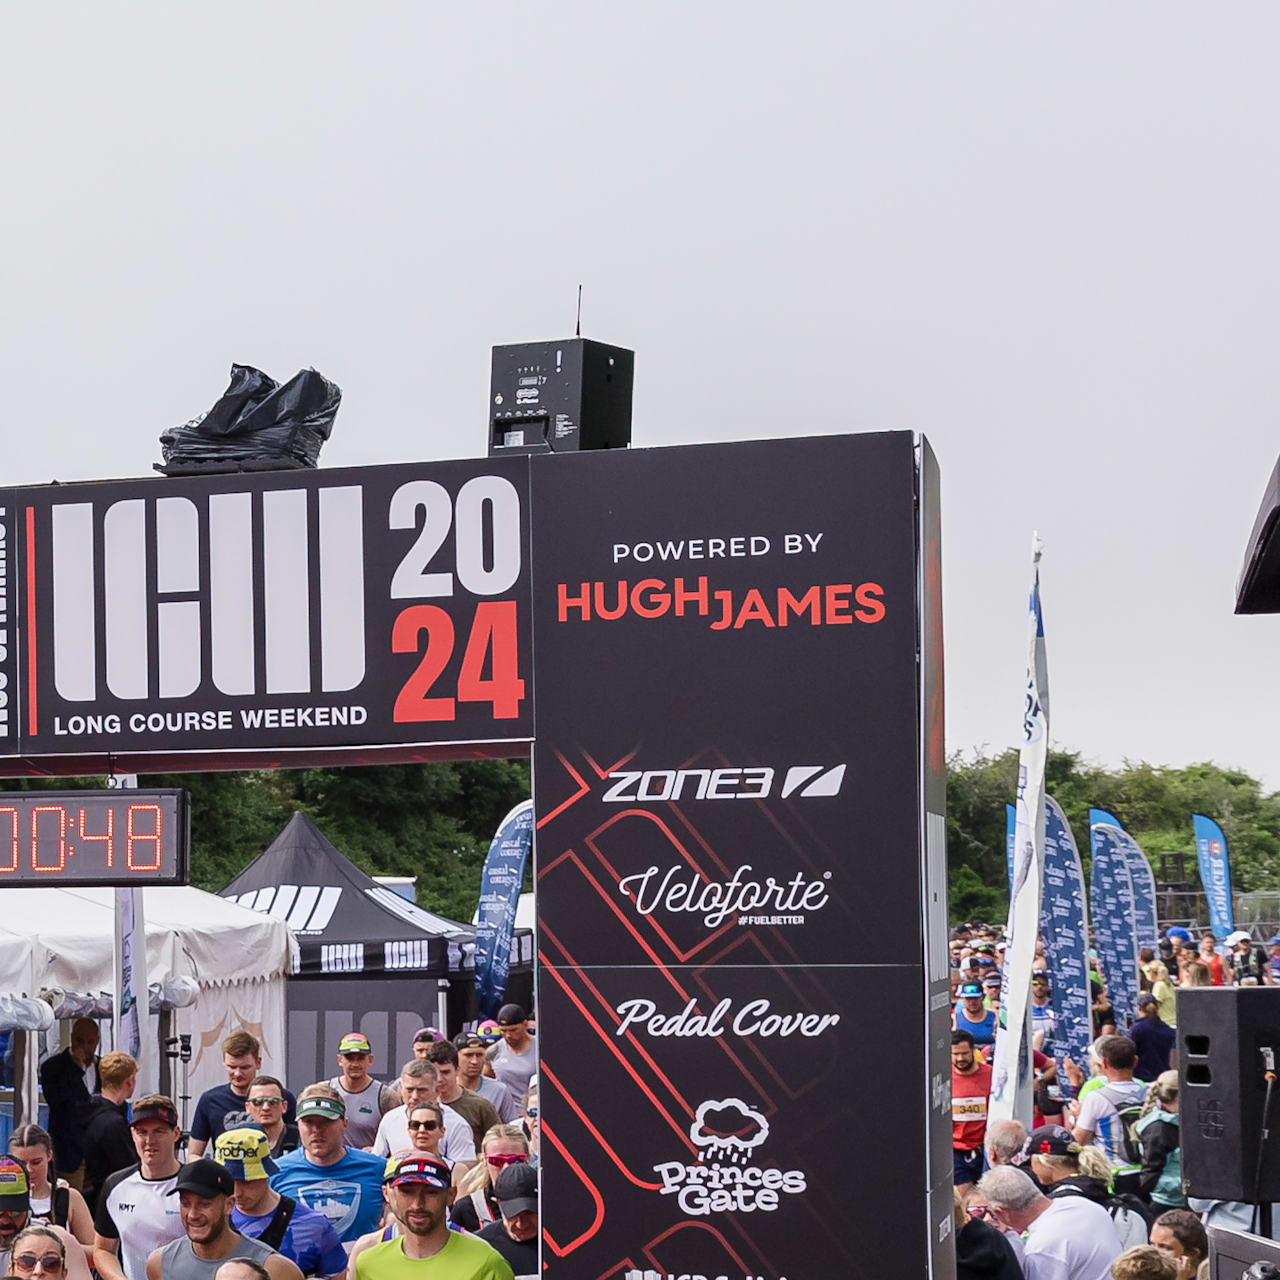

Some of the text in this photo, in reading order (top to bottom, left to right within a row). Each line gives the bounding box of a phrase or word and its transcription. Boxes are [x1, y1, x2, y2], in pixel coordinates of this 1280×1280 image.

[388, 476, 521, 600] 20
[612, 532, 824, 564] POWERED BY
[392, 600, 525, 723] 24
[53, 705, 368, 736] LONG COURSE WEEKEND
[602, 766, 772, 803] ZONE3
[618, 864, 826, 928] Veloforte
[737, 914, 805, 926] #FUELBETTER
[616, 997, 840, 1039] Pedal Cover
[653, 1159, 807, 1197] Princes
[677, 1183, 780, 1216] Gate
